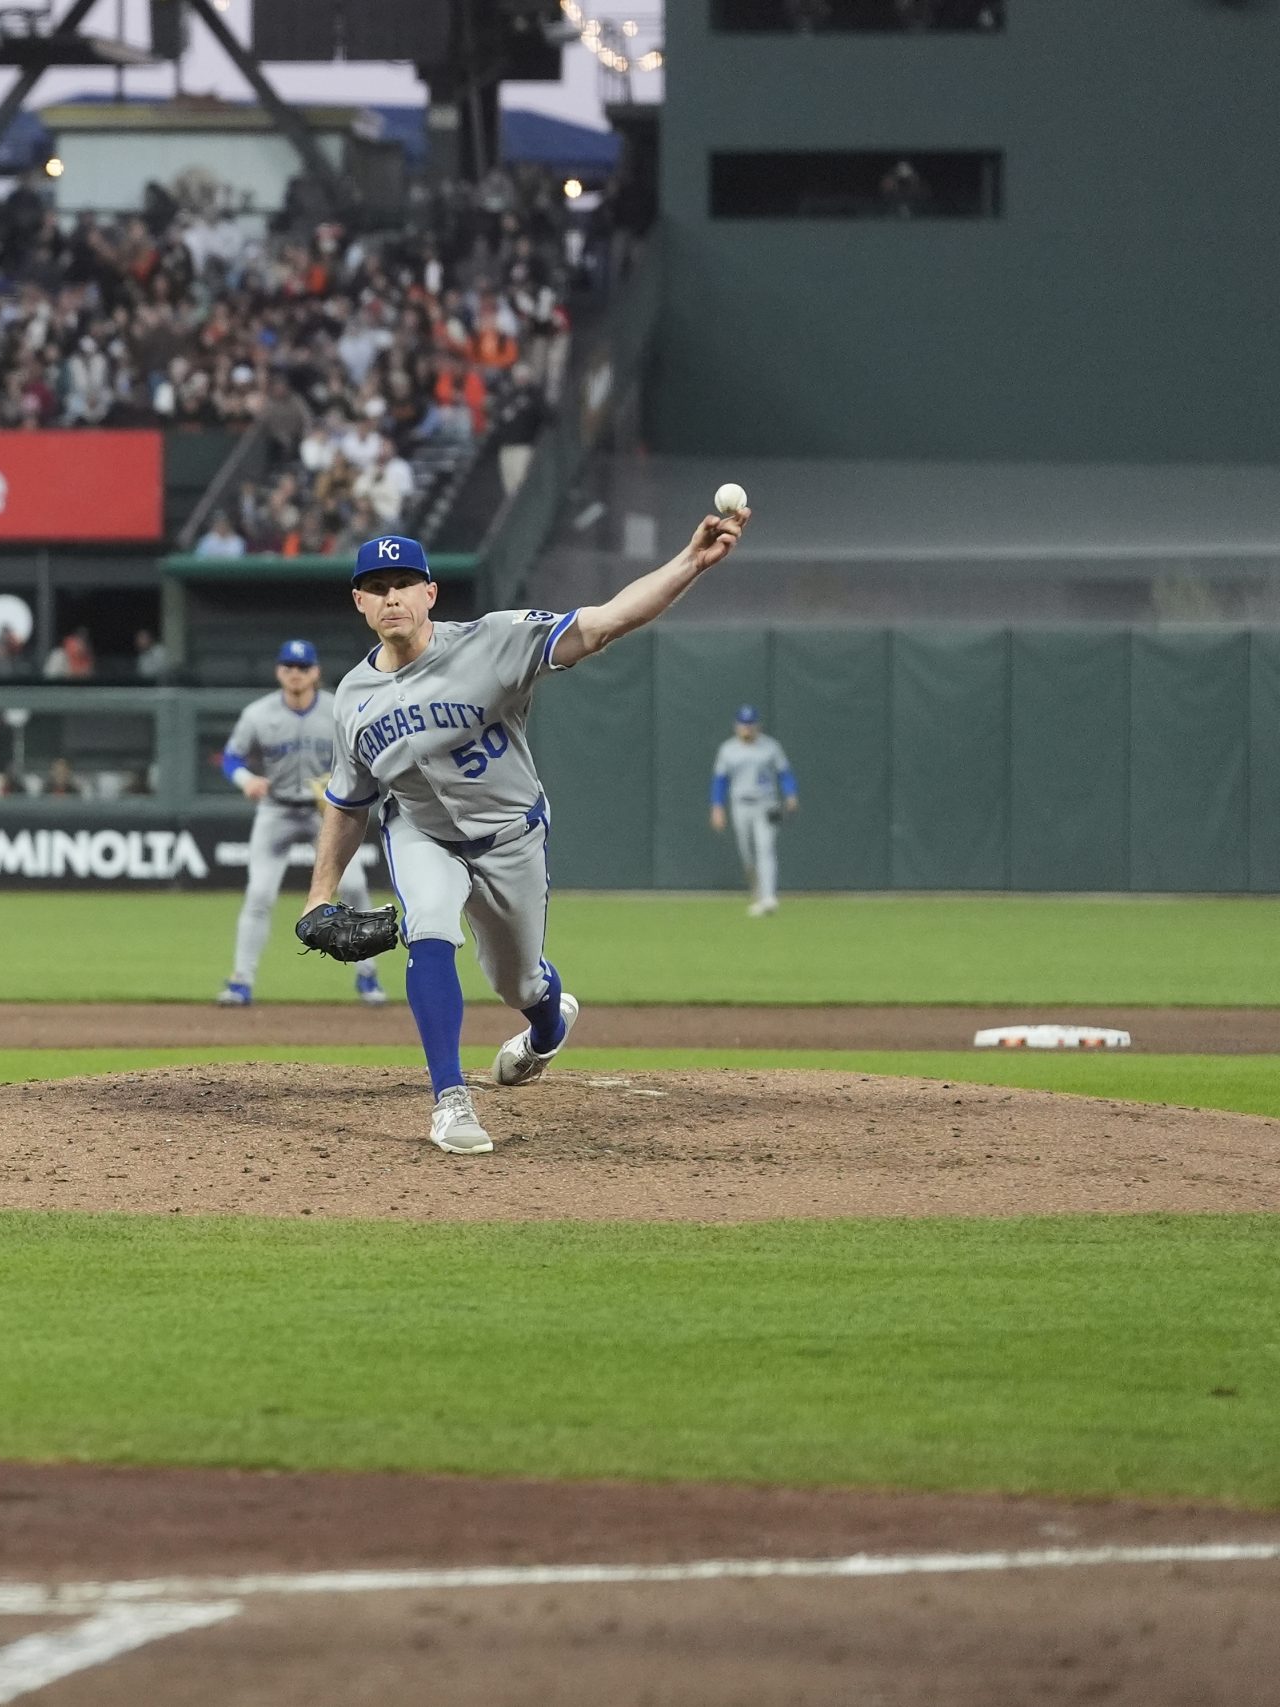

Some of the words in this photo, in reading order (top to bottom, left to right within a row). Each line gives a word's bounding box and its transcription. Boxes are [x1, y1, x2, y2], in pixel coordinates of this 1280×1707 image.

[378, 539, 400, 560] KC
[358, 704, 426, 766] KANSAS
[430, 702, 486, 729] CITY
[450, 722, 508, 778] 50
